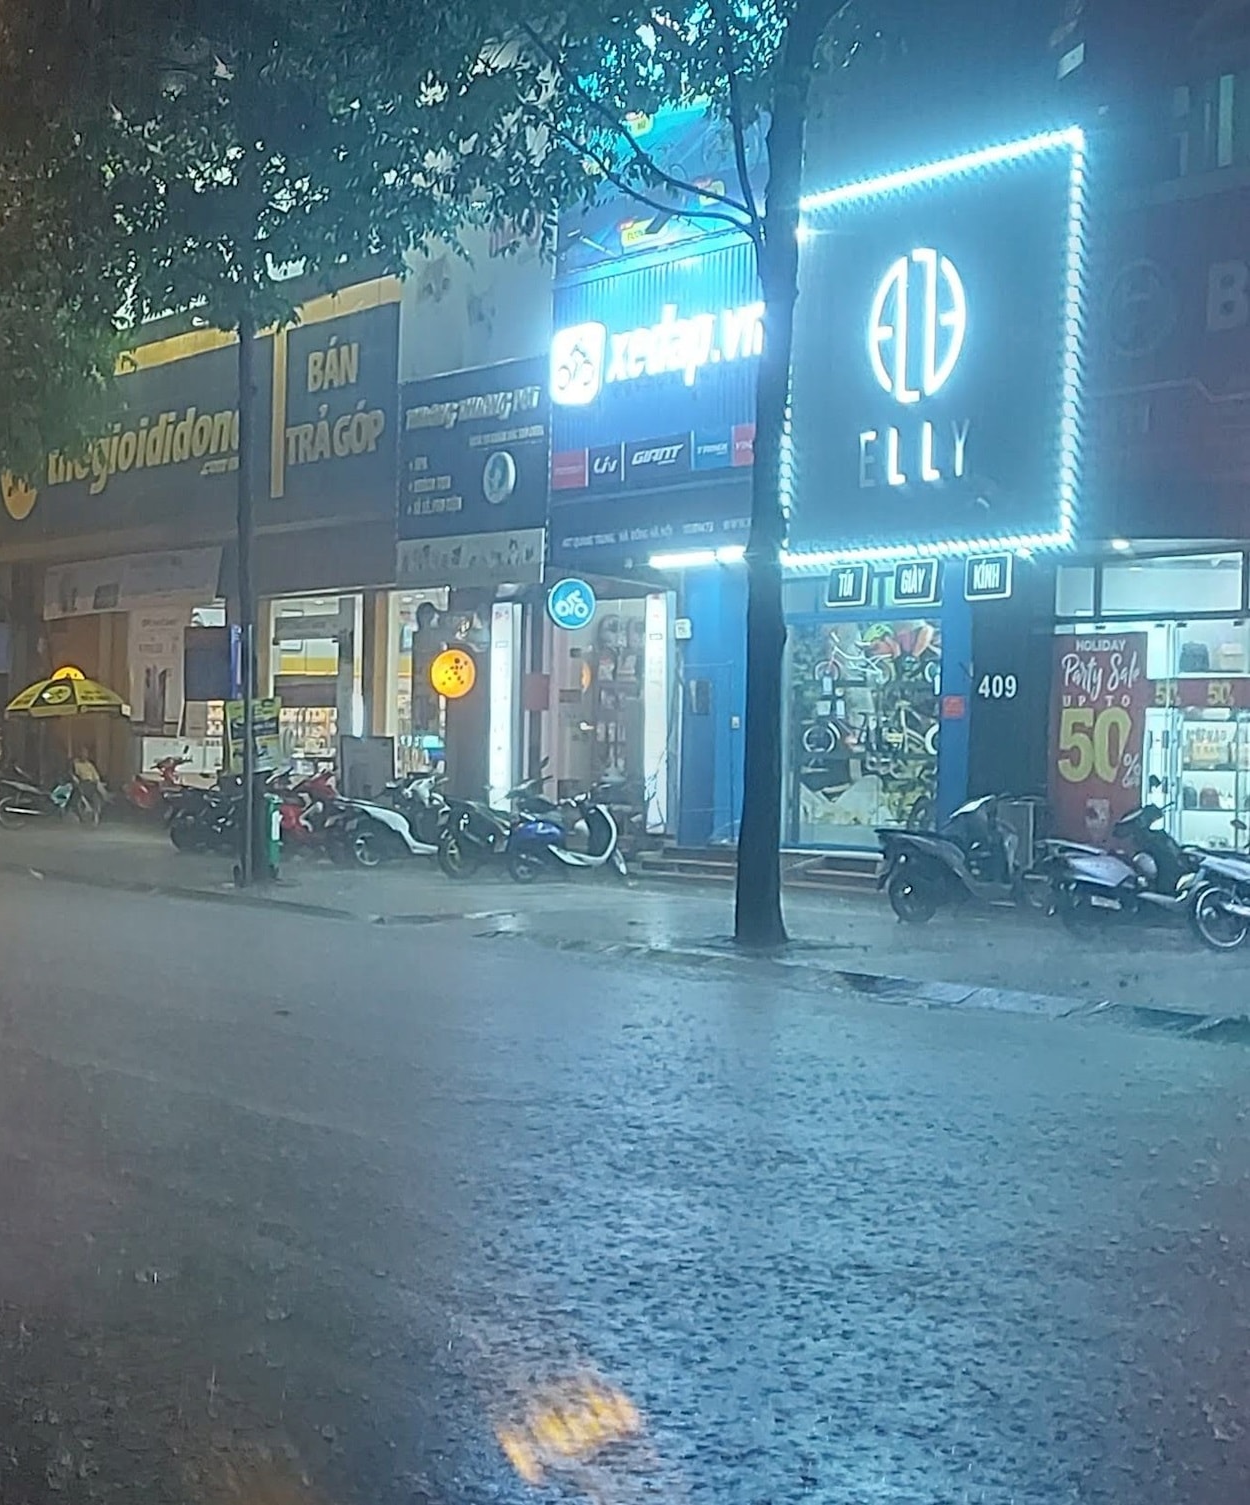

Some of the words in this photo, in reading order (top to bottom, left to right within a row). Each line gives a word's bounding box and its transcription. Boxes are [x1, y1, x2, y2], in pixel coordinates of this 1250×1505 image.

[308, 336, 359, 393] BÁN
[285, 403, 332, 465] TRẢ
[333, 399, 385, 457] GÓP
[631, 443, 684, 466] GIANT
[859, 419, 970, 488] ELLY
[838, 572, 855, 597] TÚI
[901, 565, 926, 594] GIÀY
[973, 560, 1001, 590] KÍNH
[1076, 639, 1126, 652] HOLIDAY
[978, 674, 1017, 698] 409
[1061, 653, 1104, 701] Party
[1107, 650, 1141, 692] Sale
[1063, 695, 1087, 707] UP
[1105, 695, 1131, 707] TO
